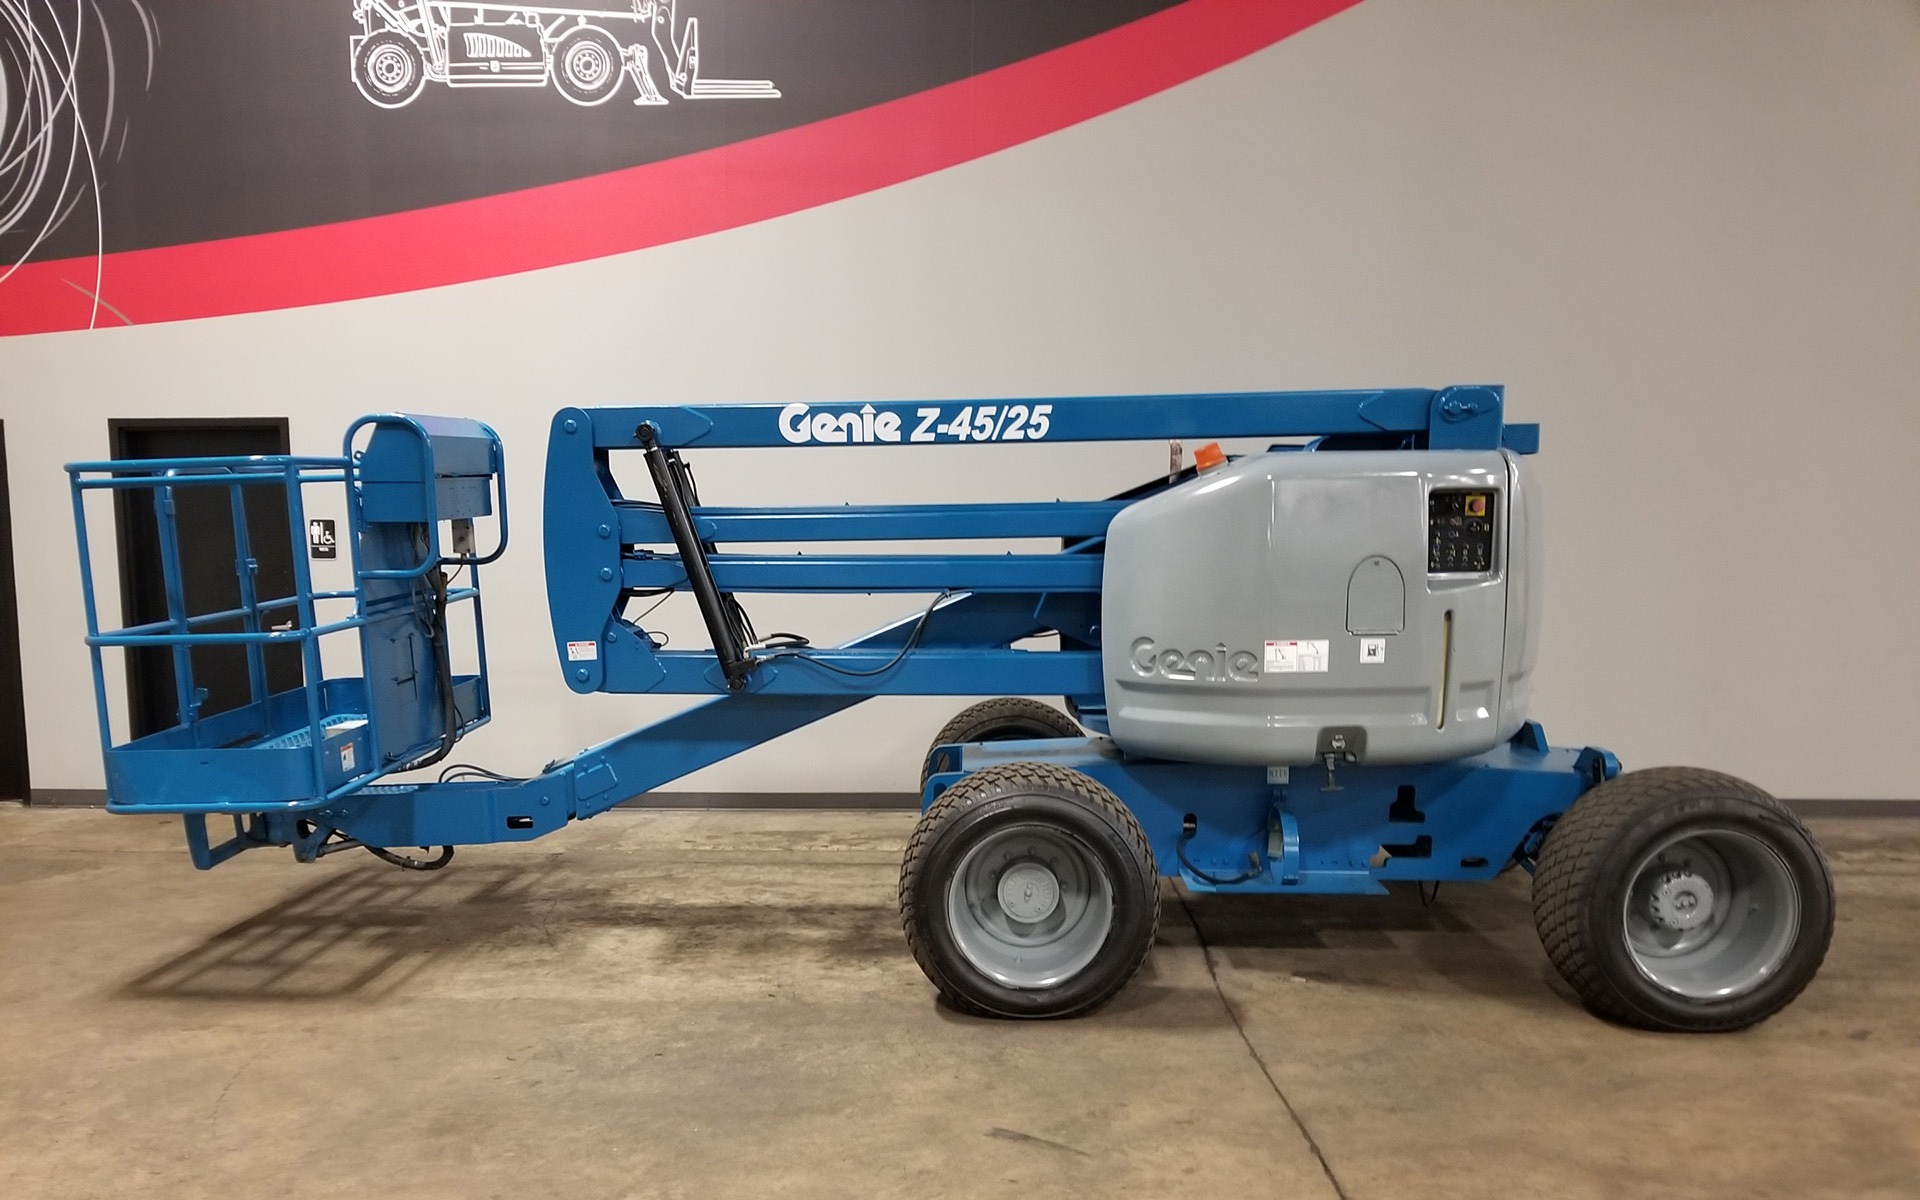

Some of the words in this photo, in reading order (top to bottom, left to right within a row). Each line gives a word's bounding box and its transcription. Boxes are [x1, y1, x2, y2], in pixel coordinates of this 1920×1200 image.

[778, 402, 901, 443] Genie
[910, 404, 1053, 442] Z-45/25
[1130, 636, 1258, 682] Genie
